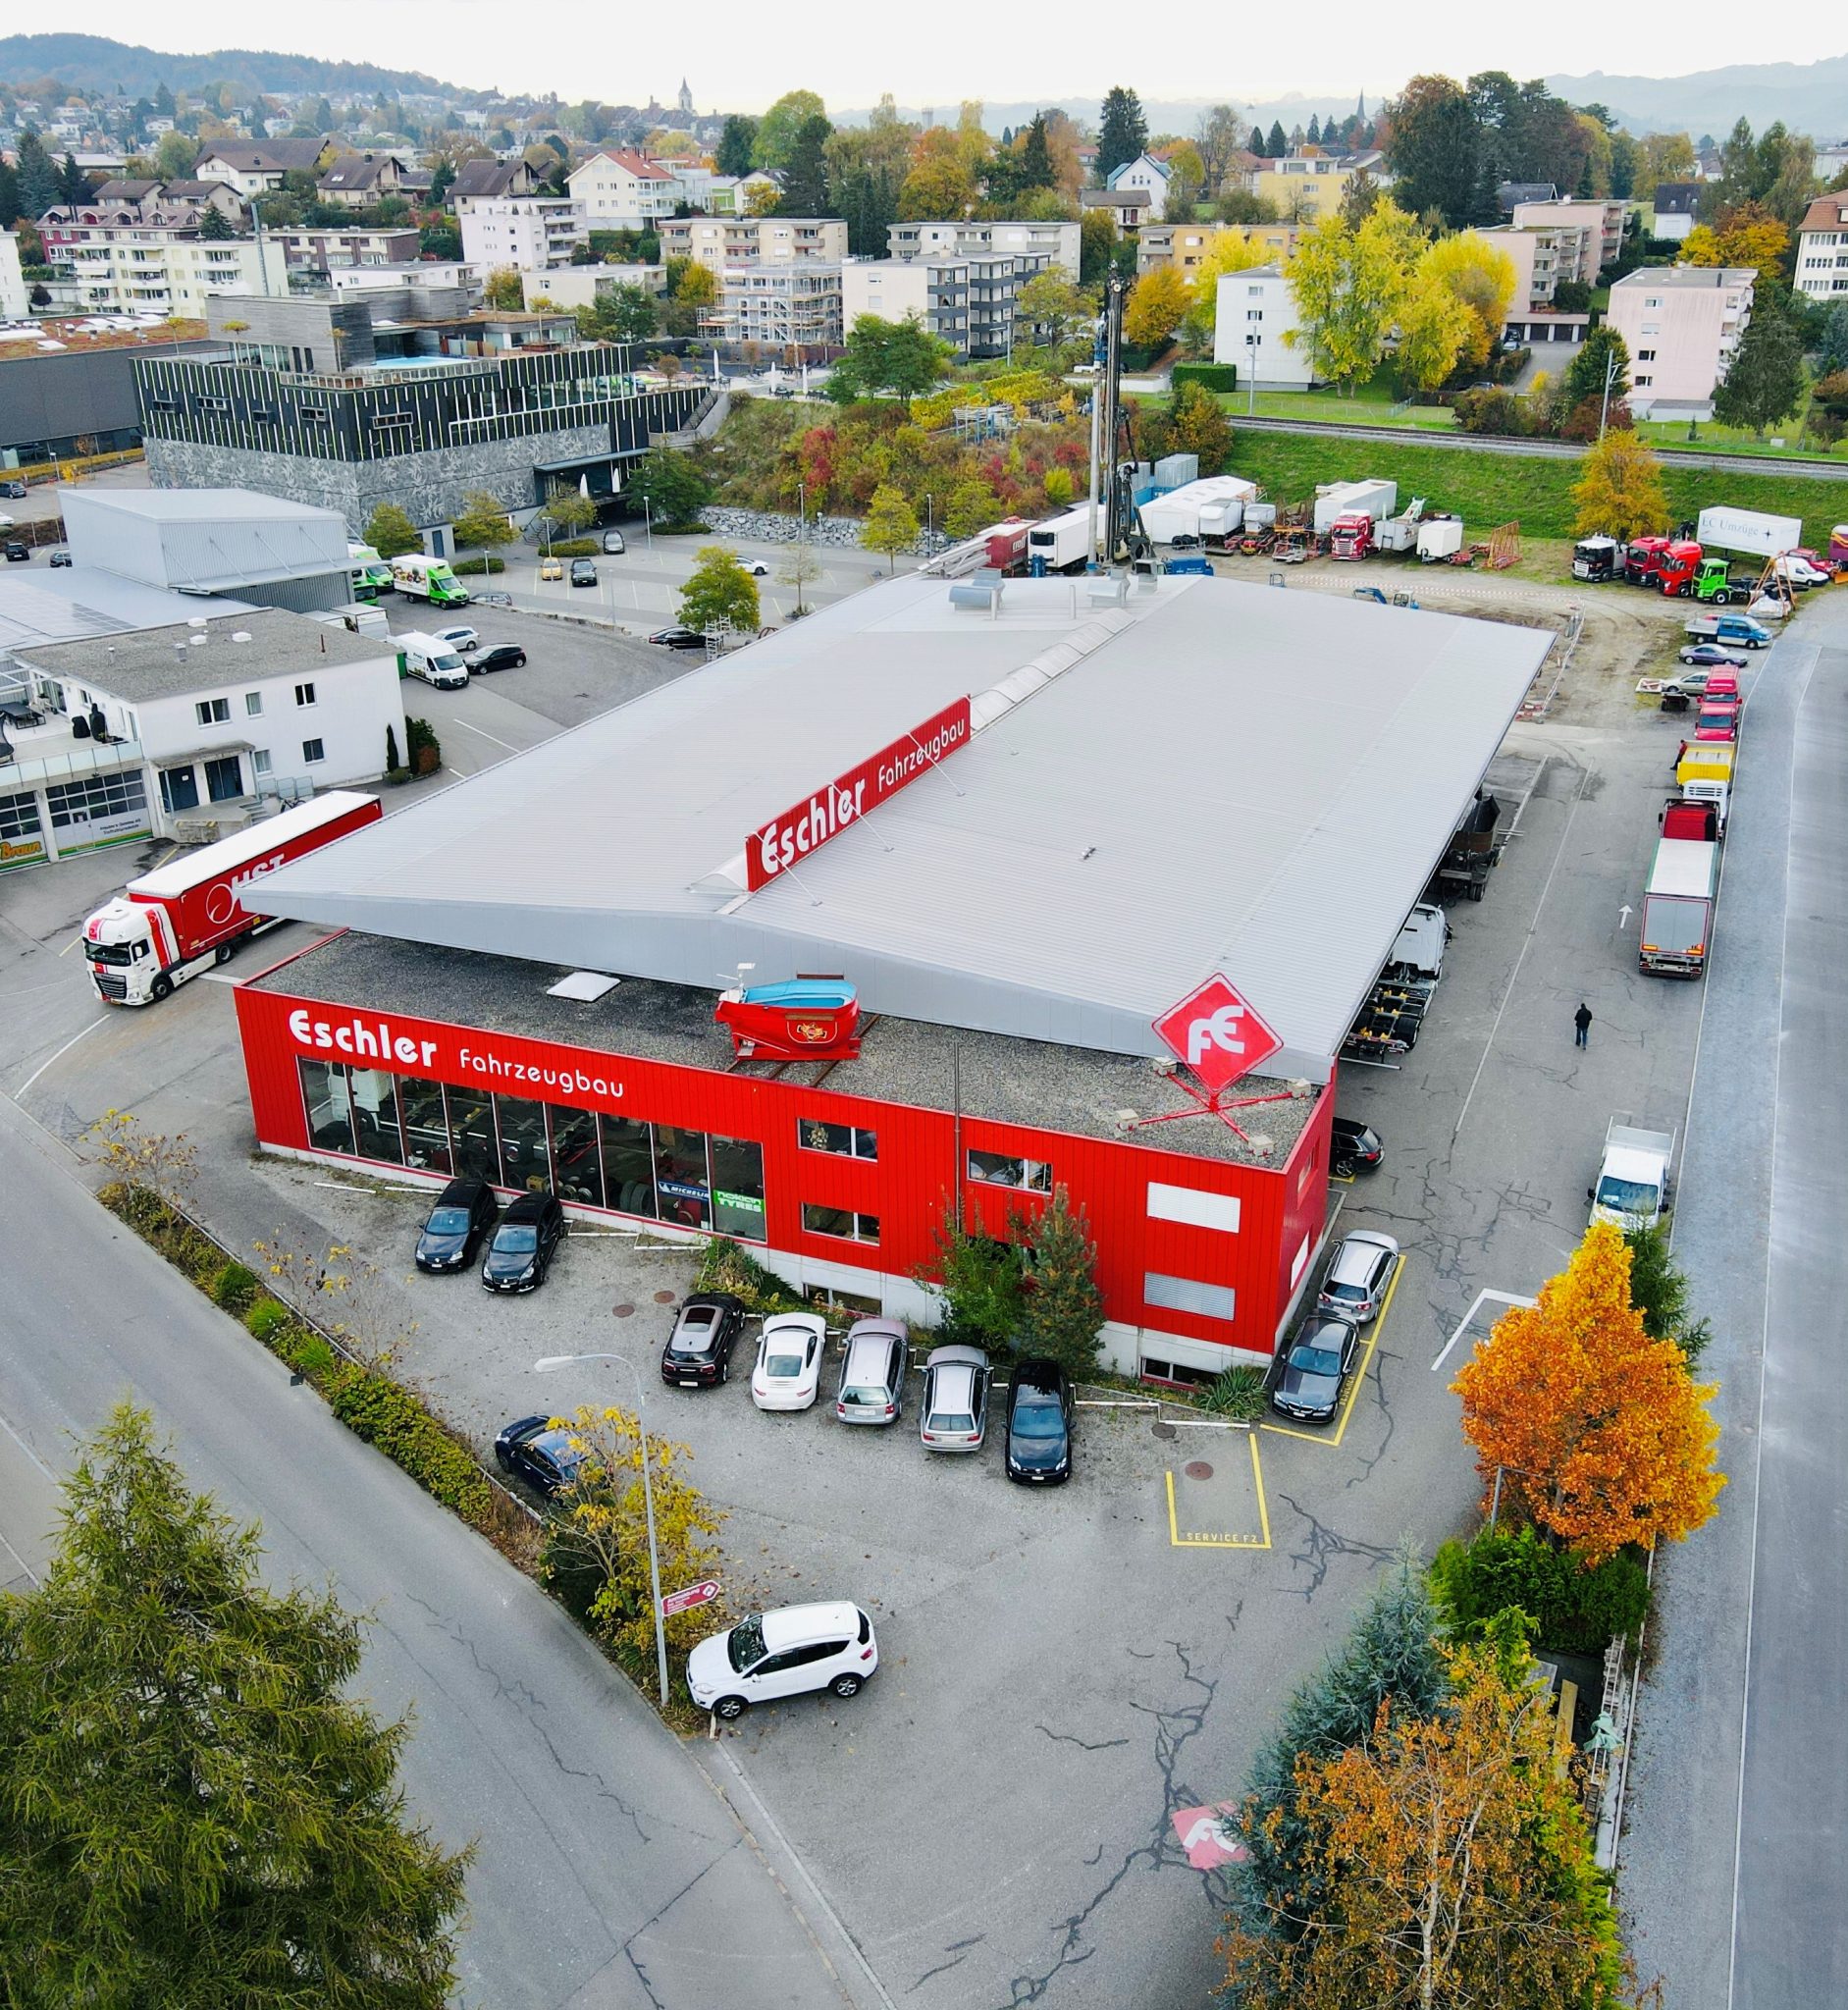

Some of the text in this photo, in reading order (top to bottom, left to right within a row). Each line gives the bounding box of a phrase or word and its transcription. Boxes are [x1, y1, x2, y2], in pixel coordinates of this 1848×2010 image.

[762, 718, 964, 874] Eschler Fahrzeugbau
[289, 1009, 624, 1098] Eschler Fahrzeugbau
[1187, 1532, 1239, 1542] SERVICE
